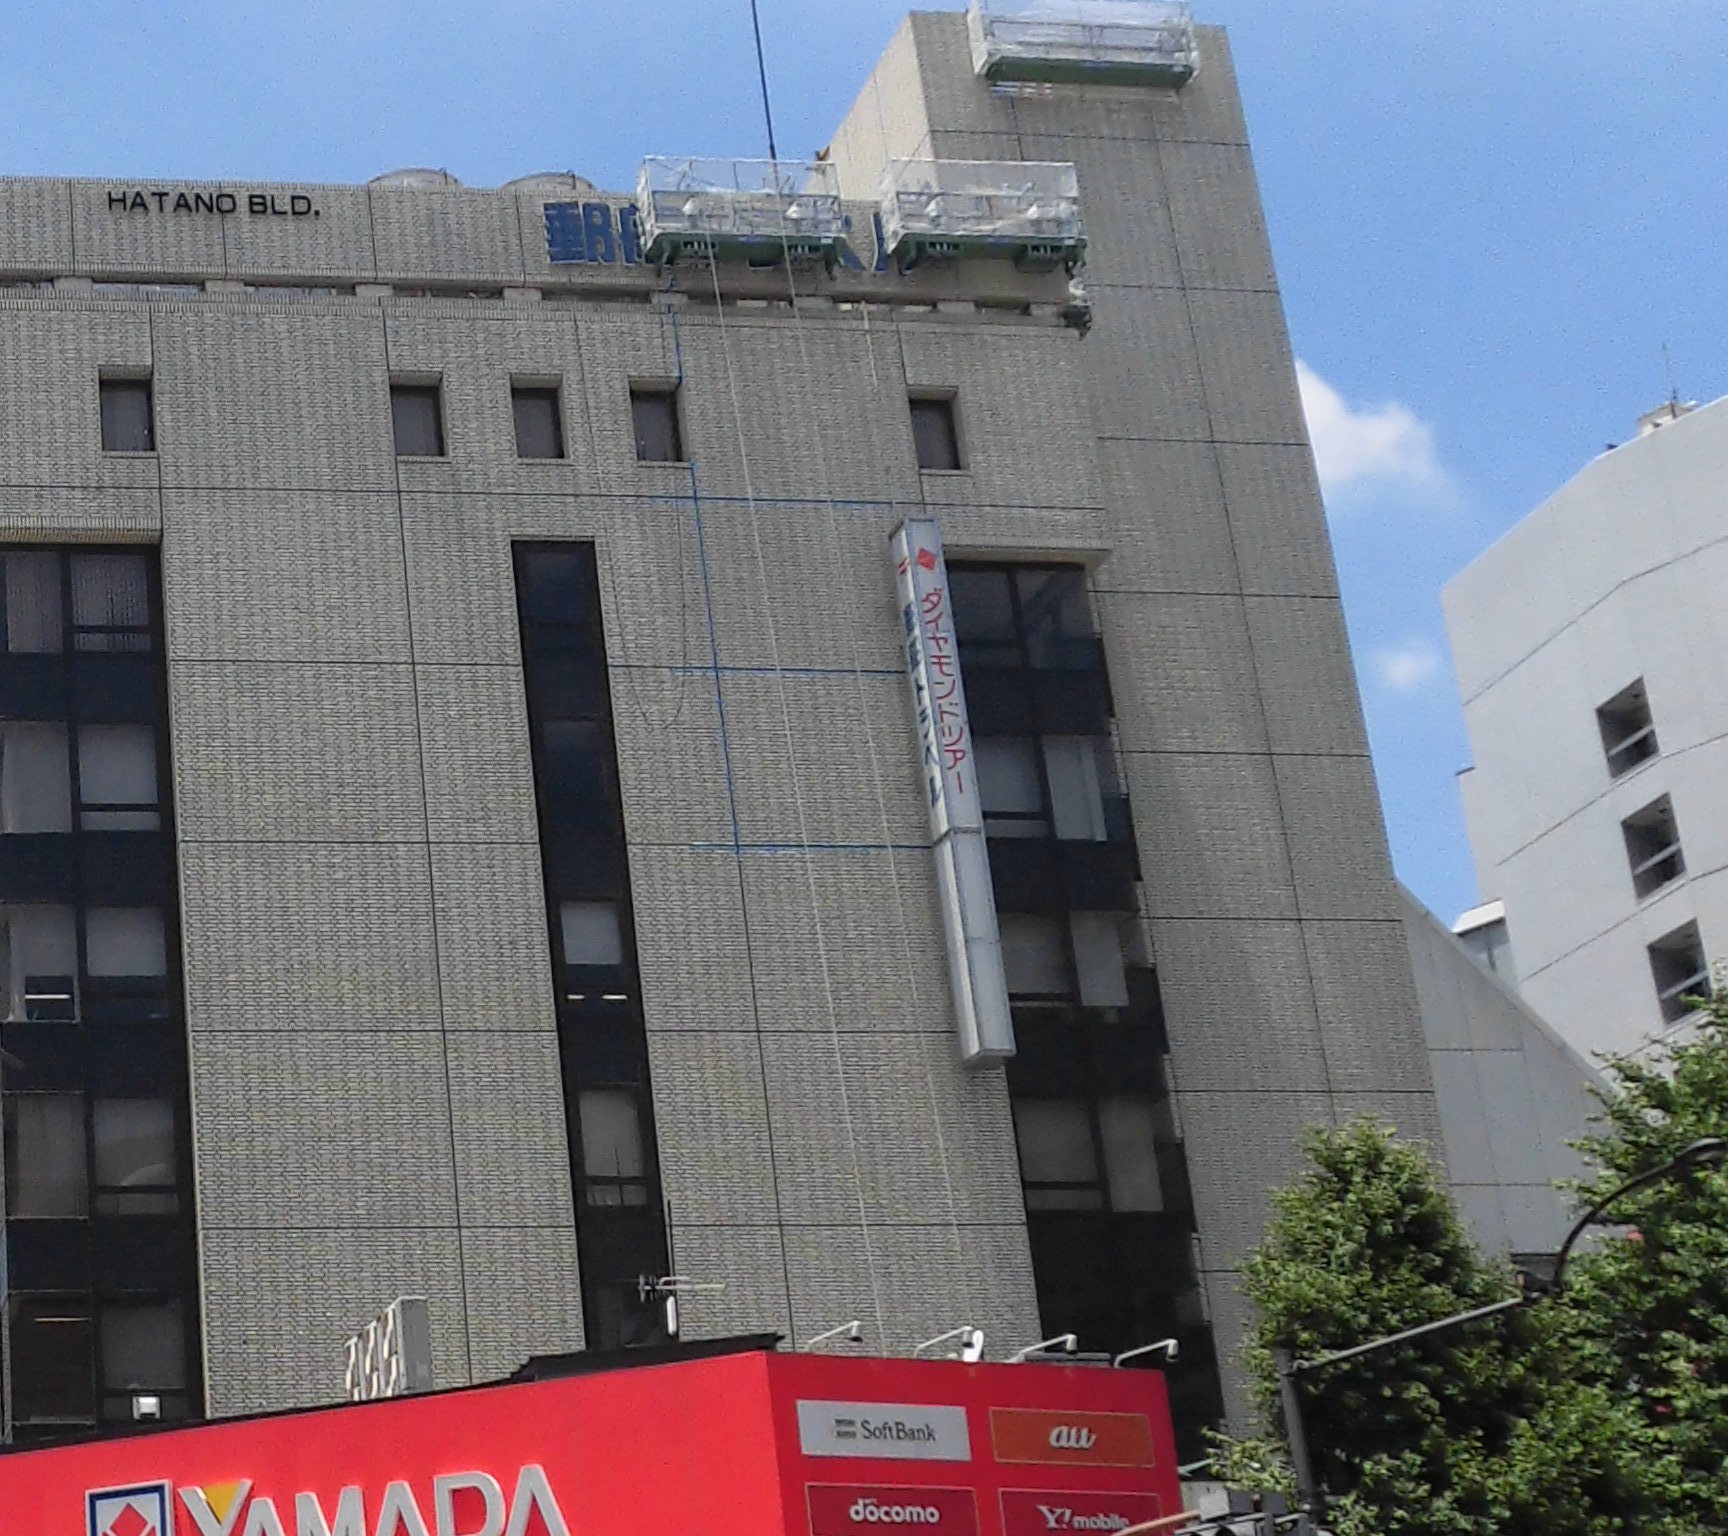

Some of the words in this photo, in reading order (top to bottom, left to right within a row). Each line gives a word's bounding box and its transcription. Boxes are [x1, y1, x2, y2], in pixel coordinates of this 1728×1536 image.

[107, 190, 237, 214] HATANO
[248, 194, 321, 217] BLD.
[922, 586, 967, 795] ダイヤモンドツアー
[860, 1418, 937, 1442] SoftBank
[1048, 1425, 1097, 1450] au
[849, 1497, 940, 1524] docomo
